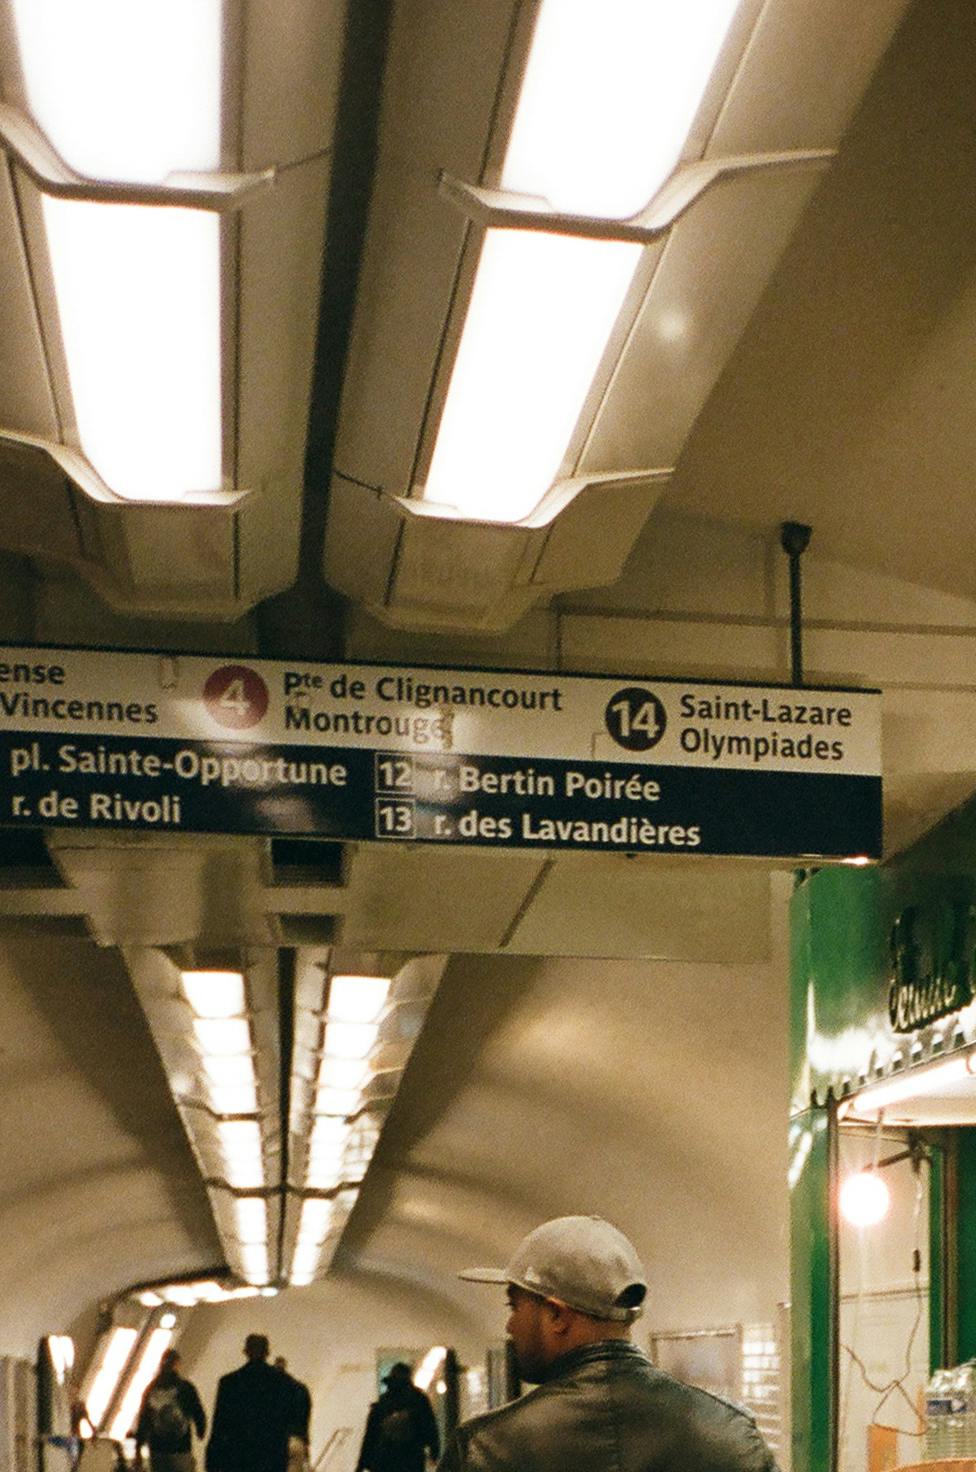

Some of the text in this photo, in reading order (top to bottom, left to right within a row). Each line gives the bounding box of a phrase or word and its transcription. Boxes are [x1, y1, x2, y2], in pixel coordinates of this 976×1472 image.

[0, 692, 158, 724] Vincennes
[219, 678, 246, 716] 4
[330, 674, 366, 699] de
[375, 676, 563, 712] Clignancourt
[680, 694, 852, 727] Saint-Lazare
[612, 700, 661, 740] 14
[680, 728, 844, 762] Olympiades
[10, 742, 348, 786] pl. Sainte-Opportune
[379, 760, 413, 788] 12
[434, 766, 662, 802] r. Bertin Poirée
[11, 790, 181, 823] r. de Rivoli
[379, 805, 413, 833] 13
[433, 809, 702, 847] r. des Lavandières
